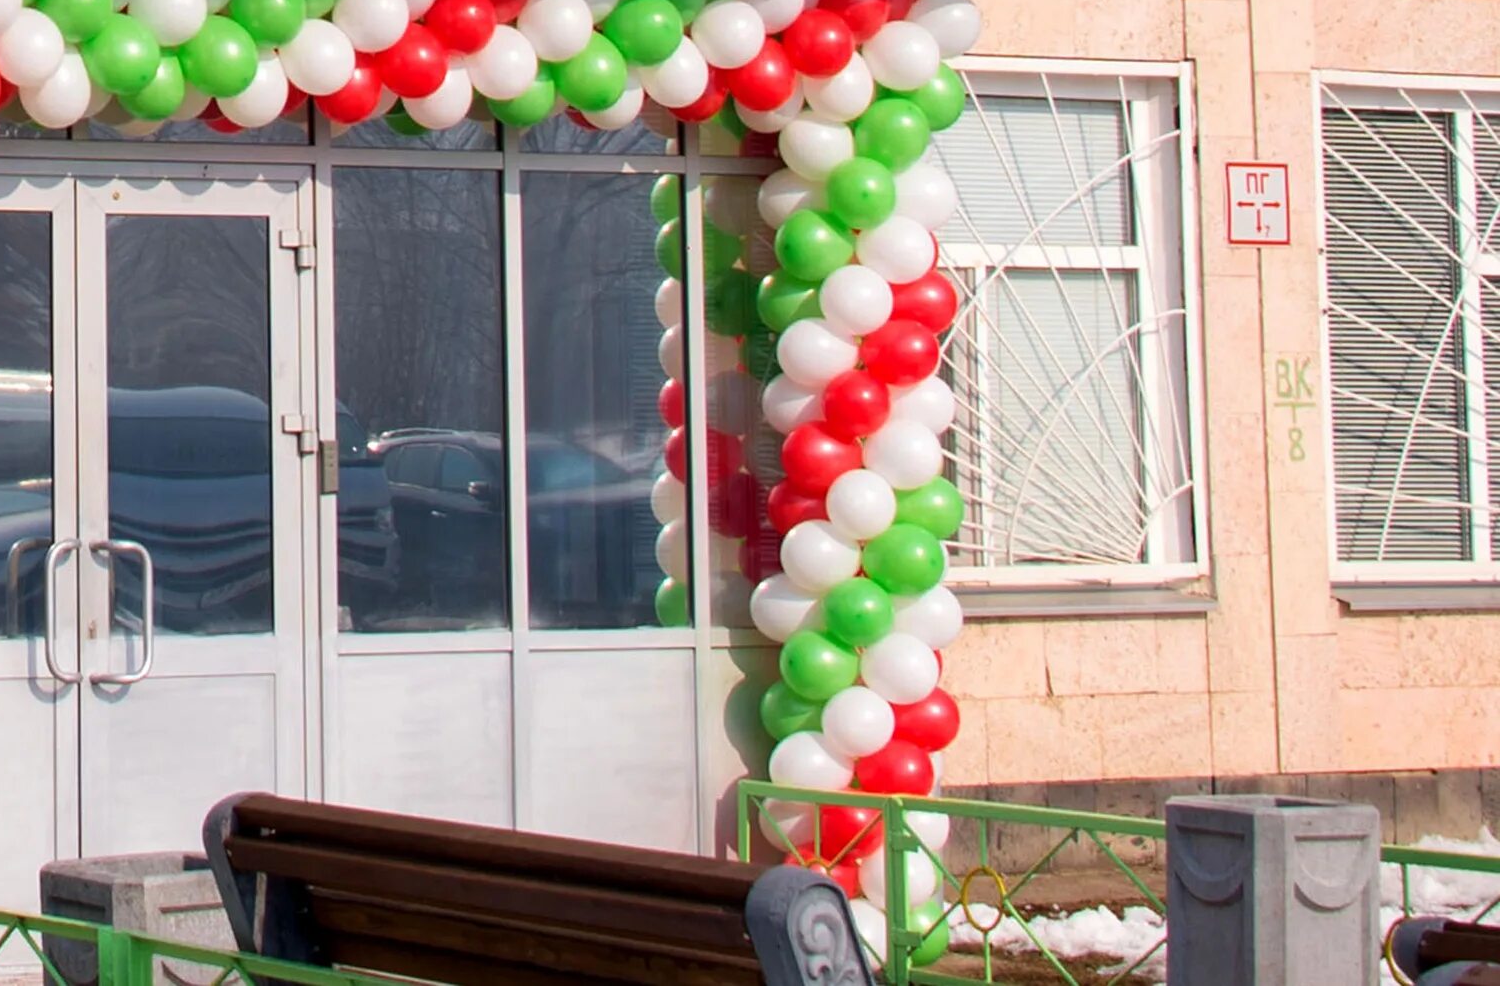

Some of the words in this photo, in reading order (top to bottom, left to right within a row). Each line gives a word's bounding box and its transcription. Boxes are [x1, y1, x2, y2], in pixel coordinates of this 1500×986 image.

[1246, 172, 1270, 194] ПГ
[1274, 358, 1314, 400] ВК
[1288, 427, 1306, 462] 8
